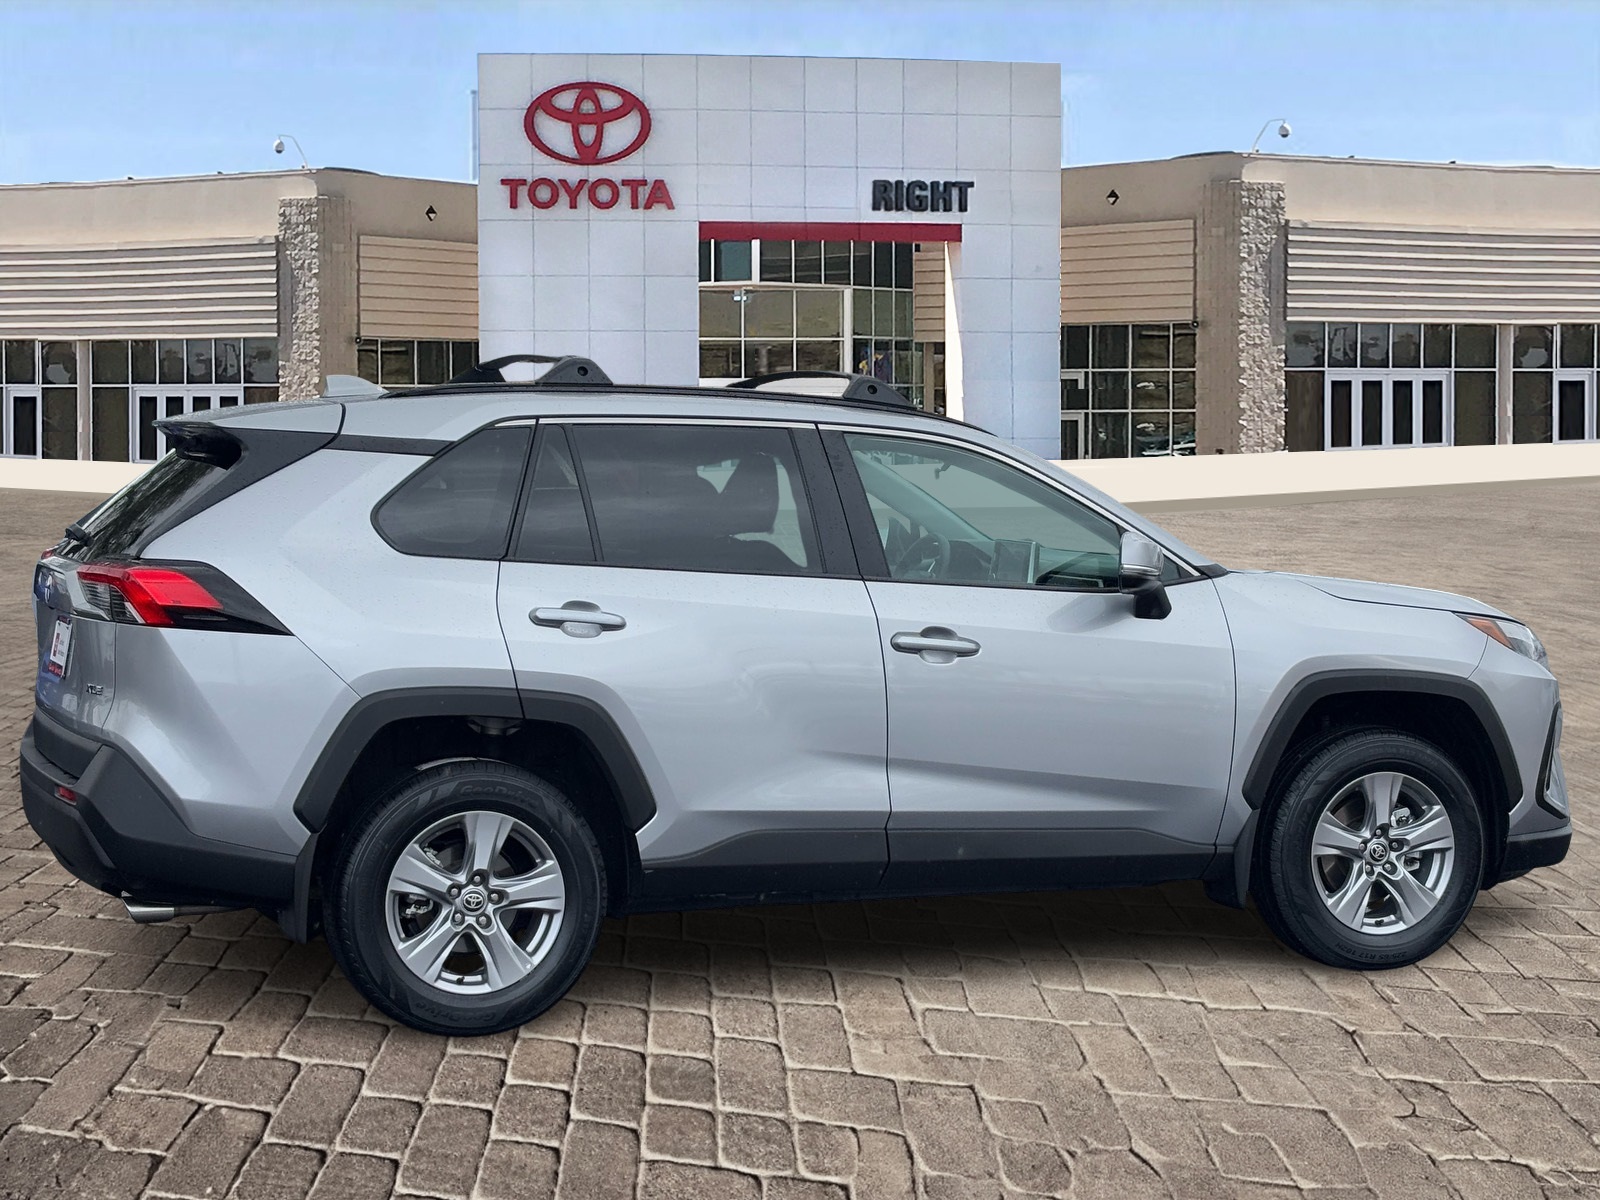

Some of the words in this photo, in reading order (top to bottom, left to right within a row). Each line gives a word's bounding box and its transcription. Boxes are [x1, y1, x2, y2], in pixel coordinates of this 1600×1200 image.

[500, 177, 675, 210] TOYOTA
[872, 180, 974, 212] RIGHT
[86, 683, 104, 695] XLE
